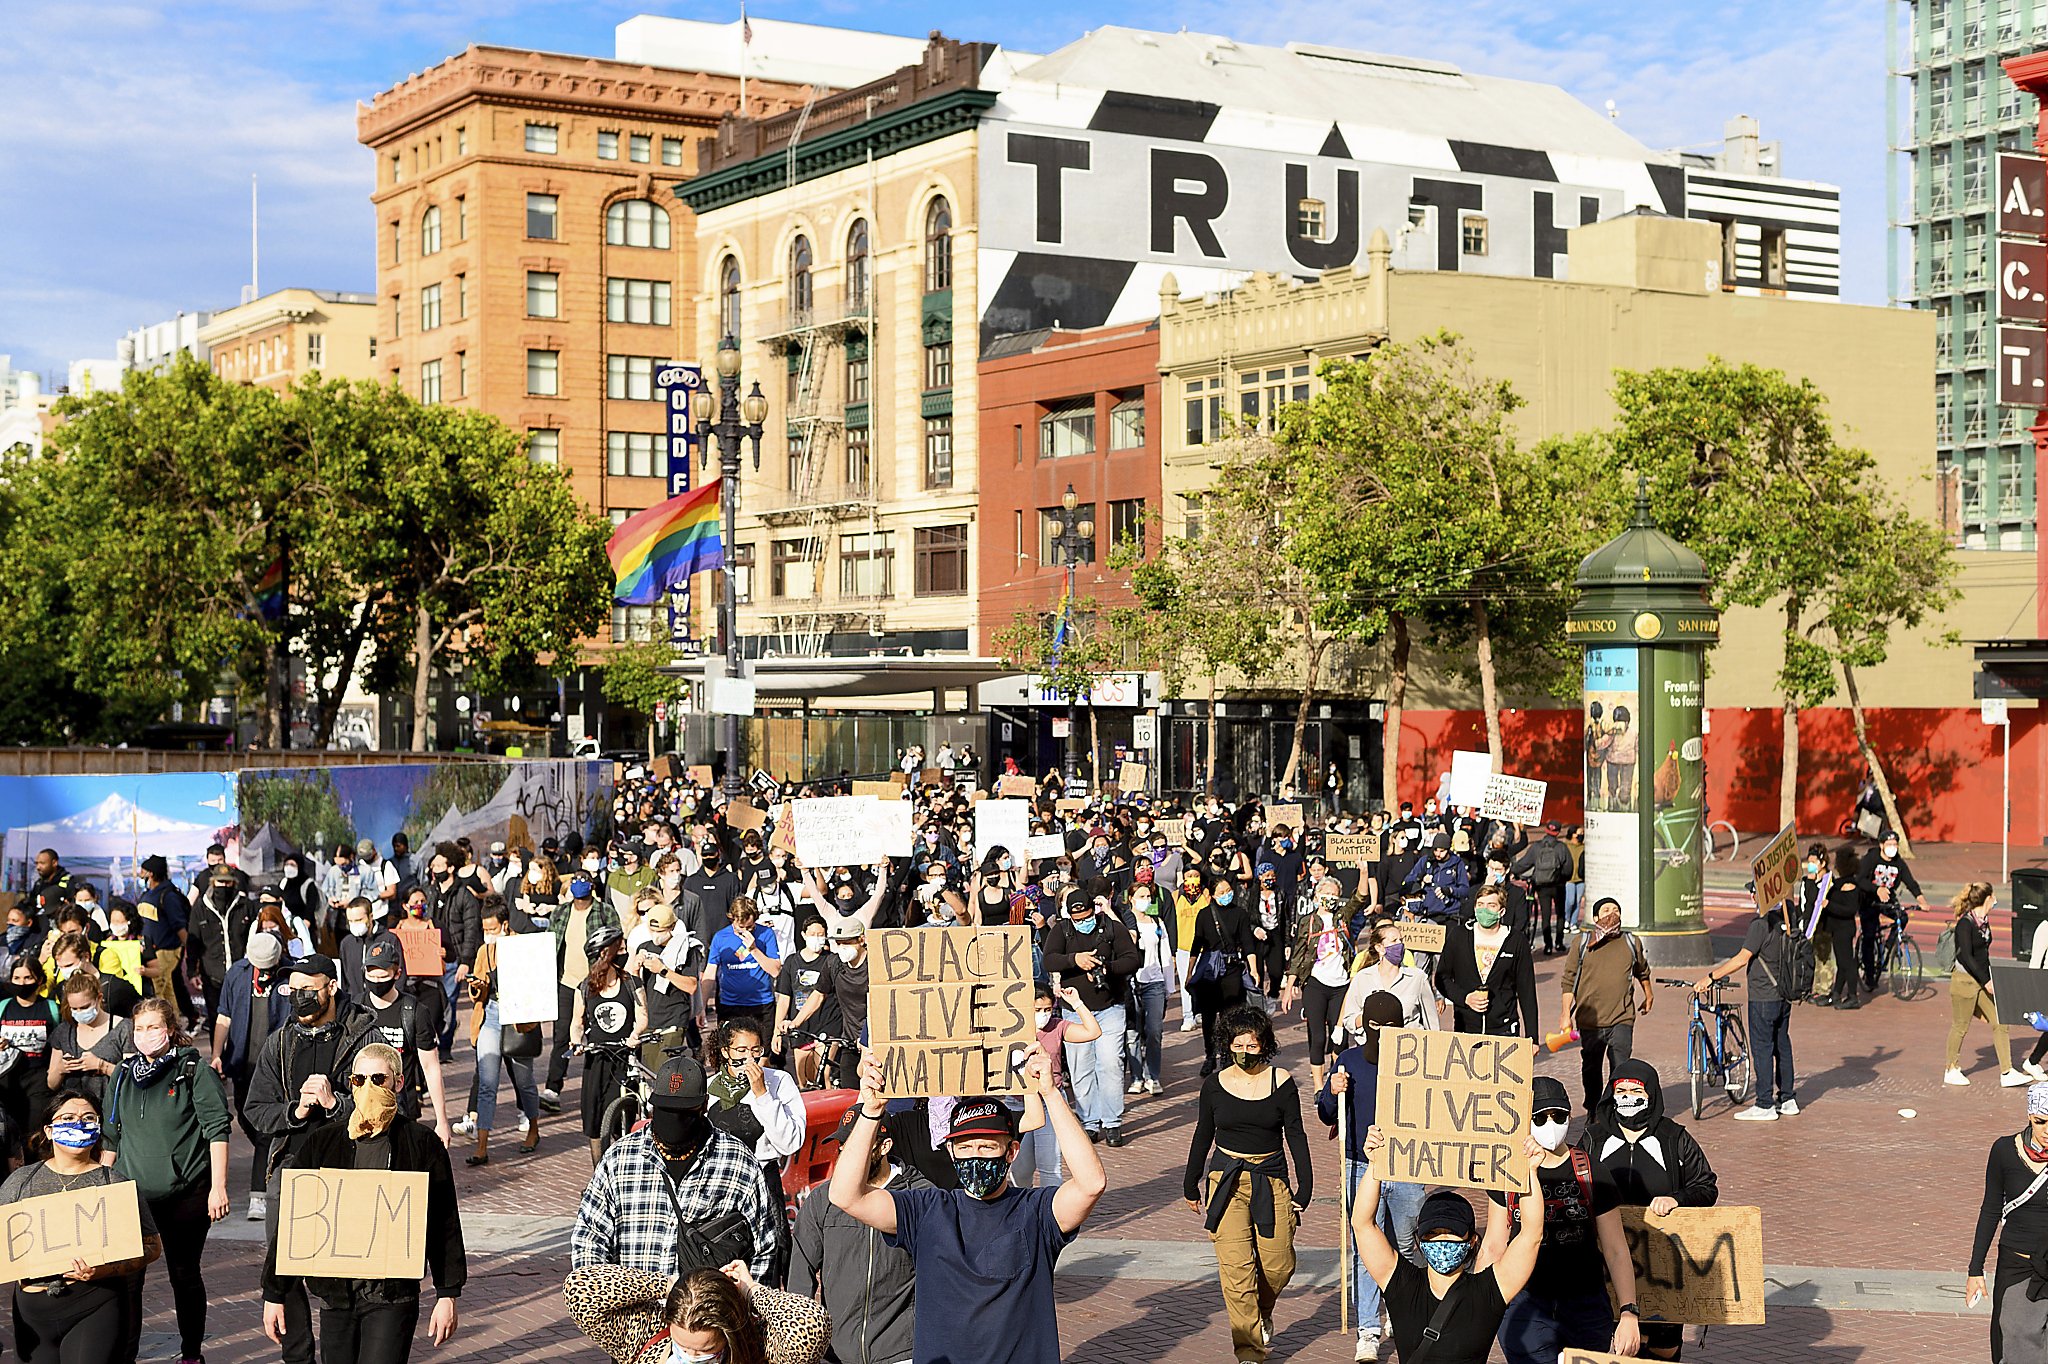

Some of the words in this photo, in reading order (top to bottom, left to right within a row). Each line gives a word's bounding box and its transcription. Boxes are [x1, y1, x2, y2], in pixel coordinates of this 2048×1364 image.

[1004, 130, 1600, 279] TRUTH
[672, 389, 687, 458] ODD
[1565, 619, 1617, 633] FRANCISCO
[1678, 619, 1699, 632] SAN
[1664, 680, 1688, 693] From
[1670, 695, 1681, 708] to
[1138, 731, 1151, 741] 10
[1330, 837, 1355, 845] BLACK
[1335, 845, 1374, 855] MATTER
[1754, 859, 1766, 882] NO
[1766, 832, 1796, 871] JUSTICE
[1762, 871, 1783, 905] NO
[404, 930, 438, 946] THEIR
[881, 929, 1024, 982] BLACK
[1420, 927, 1442, 936] LIVES
[888, 981, 1027, 1041] LIVES
[880, 1041, 1029, 1095] MATTER
[1394, 1033, 1524, 1084] BLACK
[1394, 1082, 1521, 1135] LIVES
[1389, 1136, 1522, 1187] MATTER
[7, 1196, 109, 1263] BLM
[288, 1173, 412, 1261] BLM
